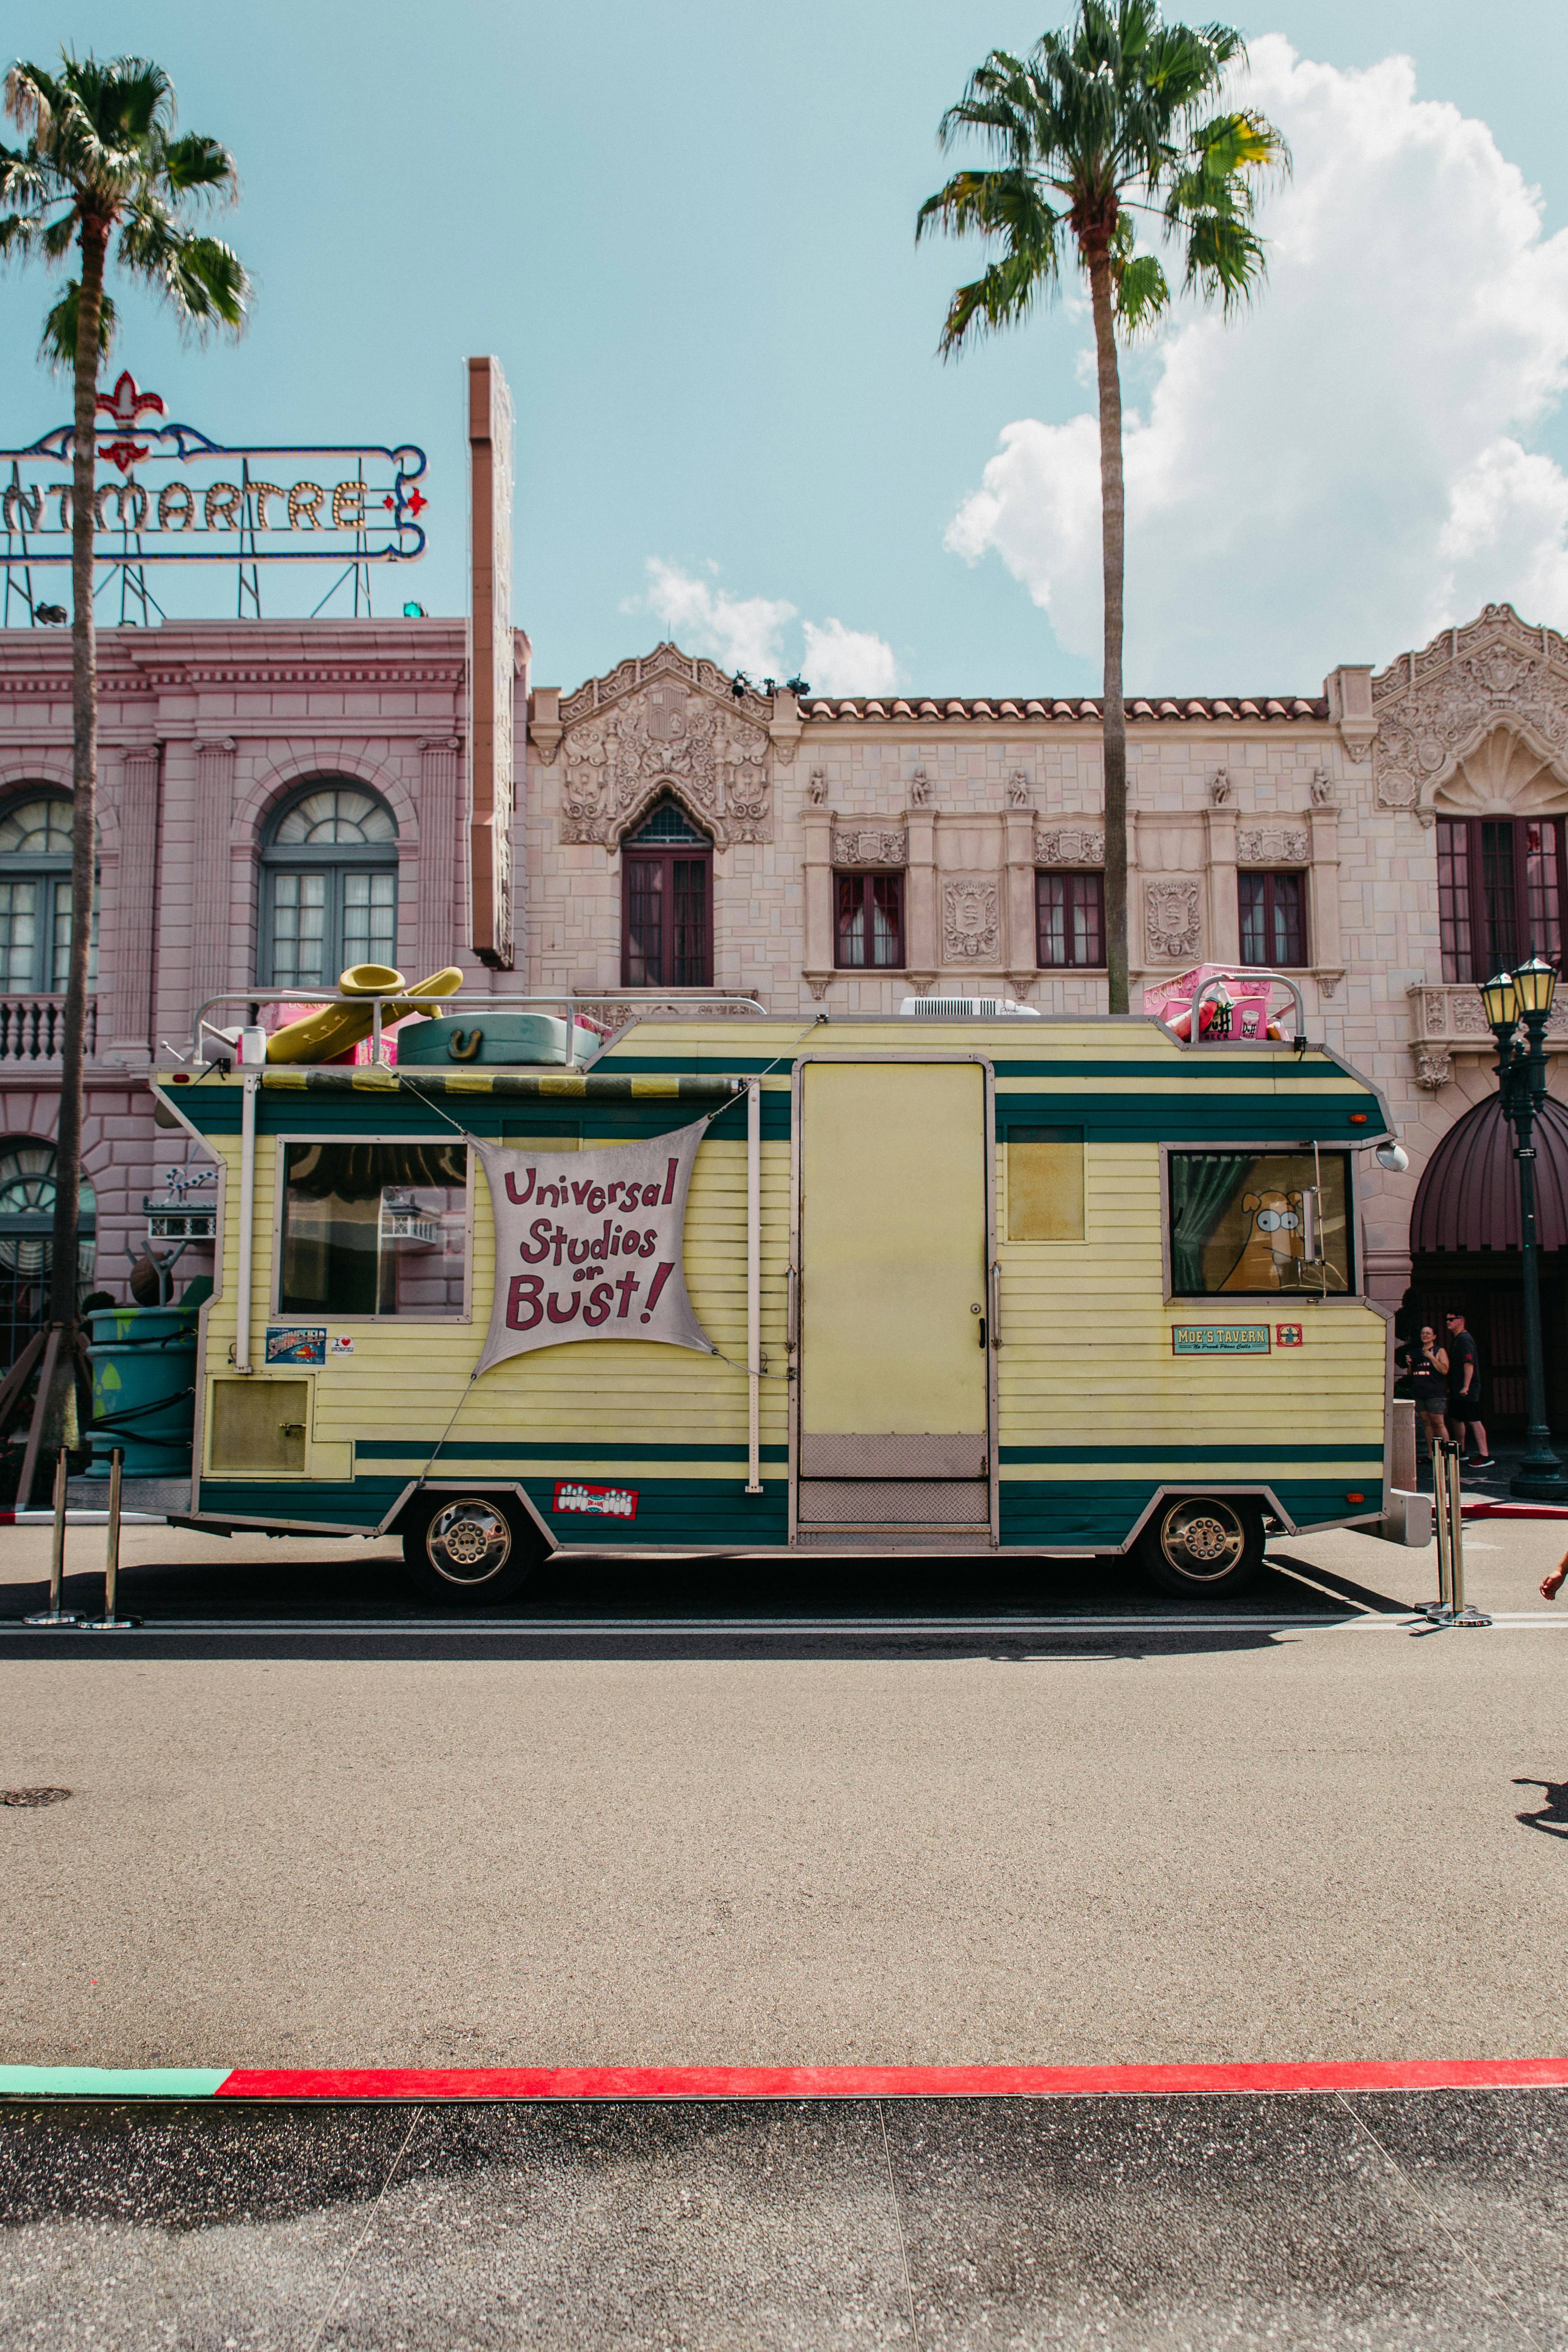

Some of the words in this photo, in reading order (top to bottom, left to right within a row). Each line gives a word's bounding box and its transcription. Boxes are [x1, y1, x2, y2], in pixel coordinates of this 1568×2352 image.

[1145, 977, 1183, 1010] DONUTS
[1242, 1022, 1257, 1034] Duff
[504, 1157, 679, 1214] Universal
[520, 1218, 657, 1266] Studios
[573, 1266, 603, 1282] or
[506, 1262, 676, 1331] Bust!
[1178, 1330, 1214, 1343] MOE'S
[1217, 1330, 1265, 1343] TAVERN
